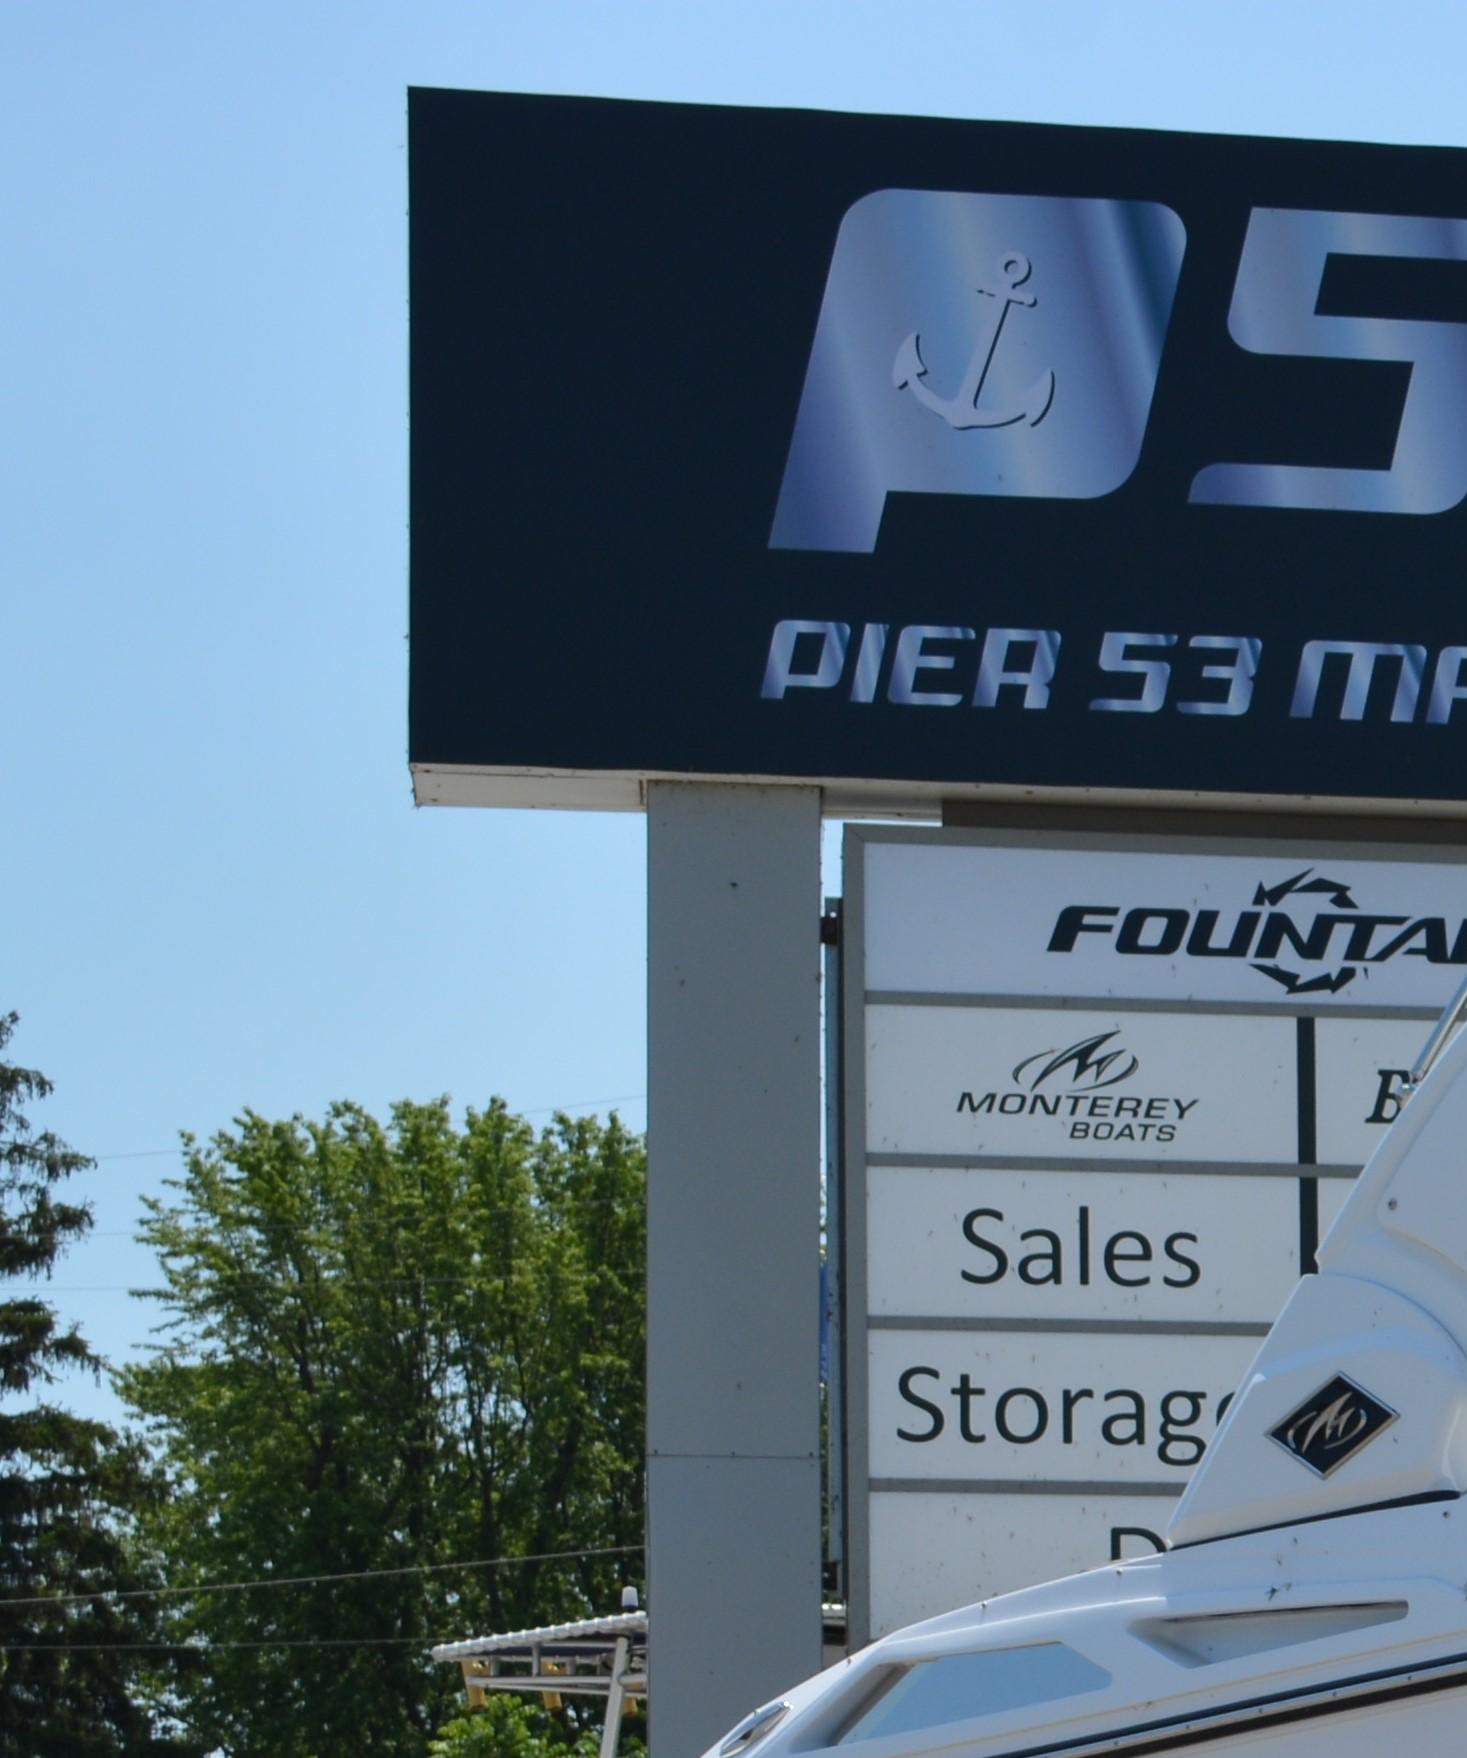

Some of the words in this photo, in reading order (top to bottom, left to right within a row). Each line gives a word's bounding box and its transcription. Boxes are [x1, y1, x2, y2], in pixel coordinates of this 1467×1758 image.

[760, 619, 1062, 710] PIER
[1089, 631, 1263, 716] 53
[956, 1091, 1199, 1120] MONTEREY
[1069, 1121, 1176, 1143] BOATS
[961, 1206, 1200, 1288] Sales
[897, 1366, 1235, 1467] Storag
